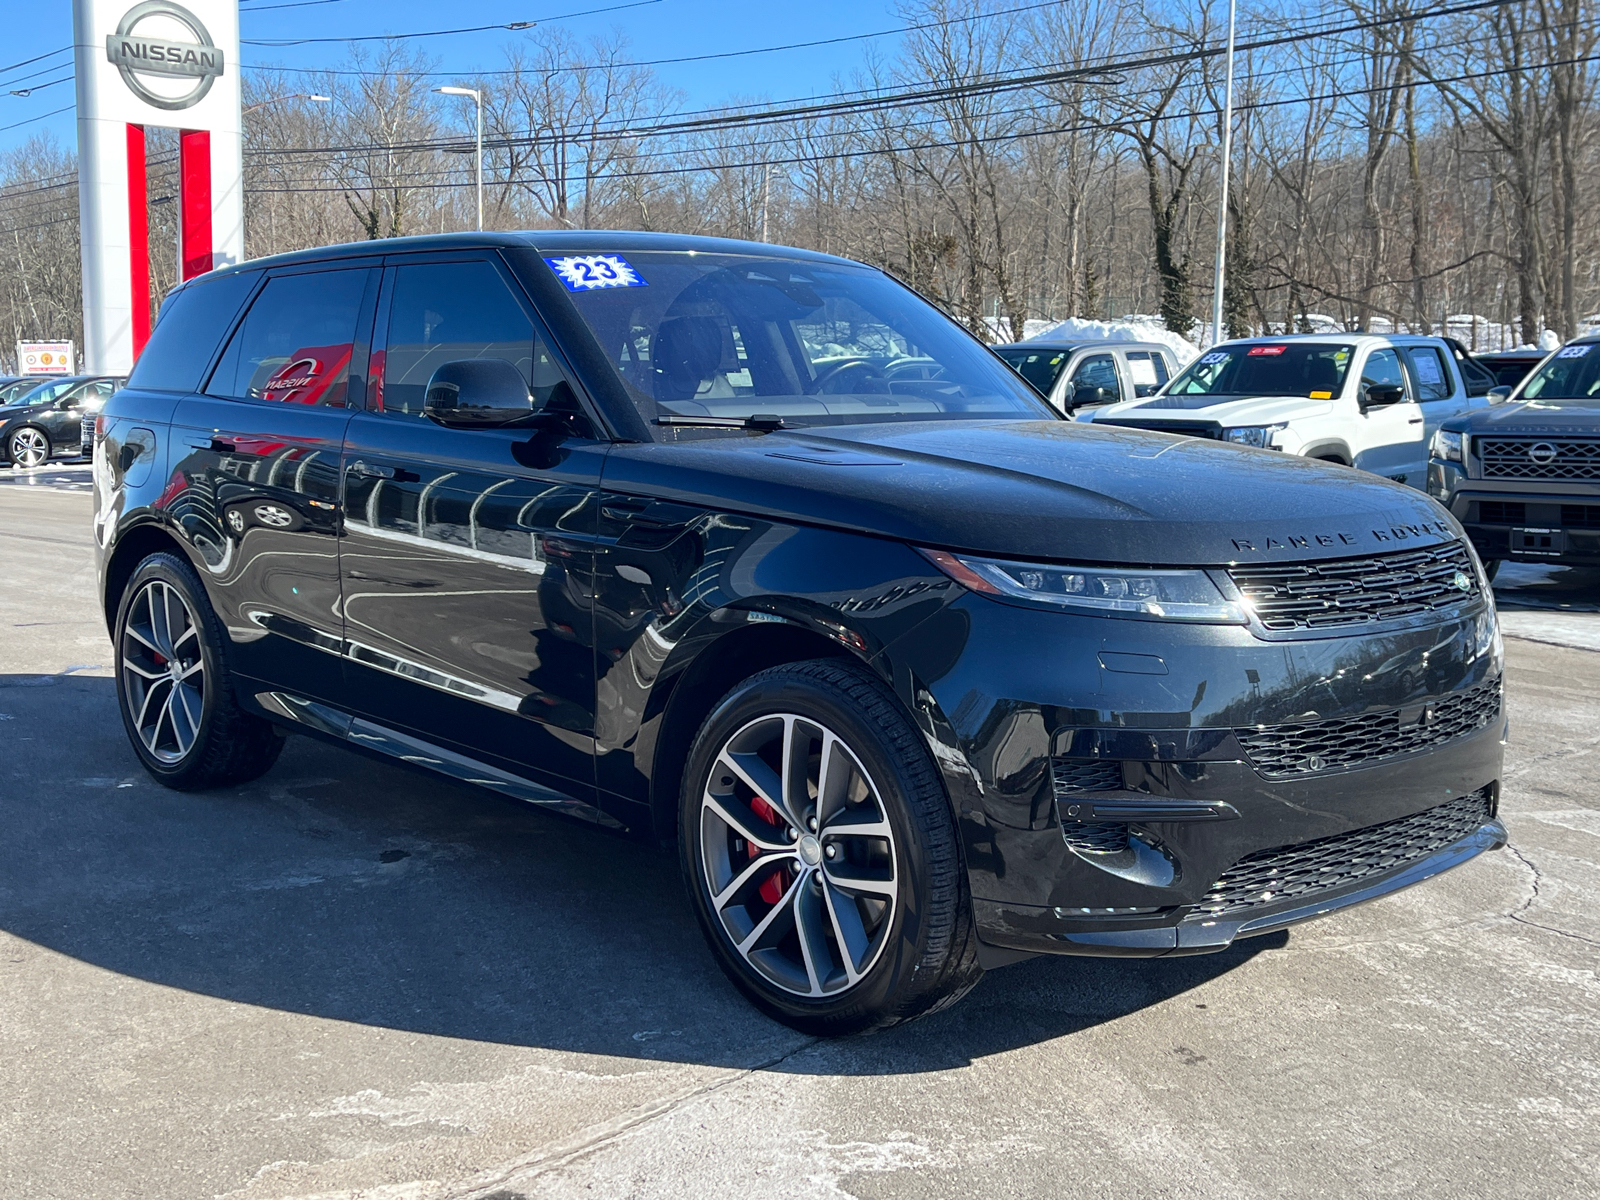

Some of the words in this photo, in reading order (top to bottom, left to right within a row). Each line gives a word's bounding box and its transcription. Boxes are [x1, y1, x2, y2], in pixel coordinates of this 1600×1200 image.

[121, 41, 215, 68] NISSAN
[573, 260, 618, 282] 23
[1231, 532, 1358, 552] RANGE
[1372, 520, 1450, 542] ROVER
